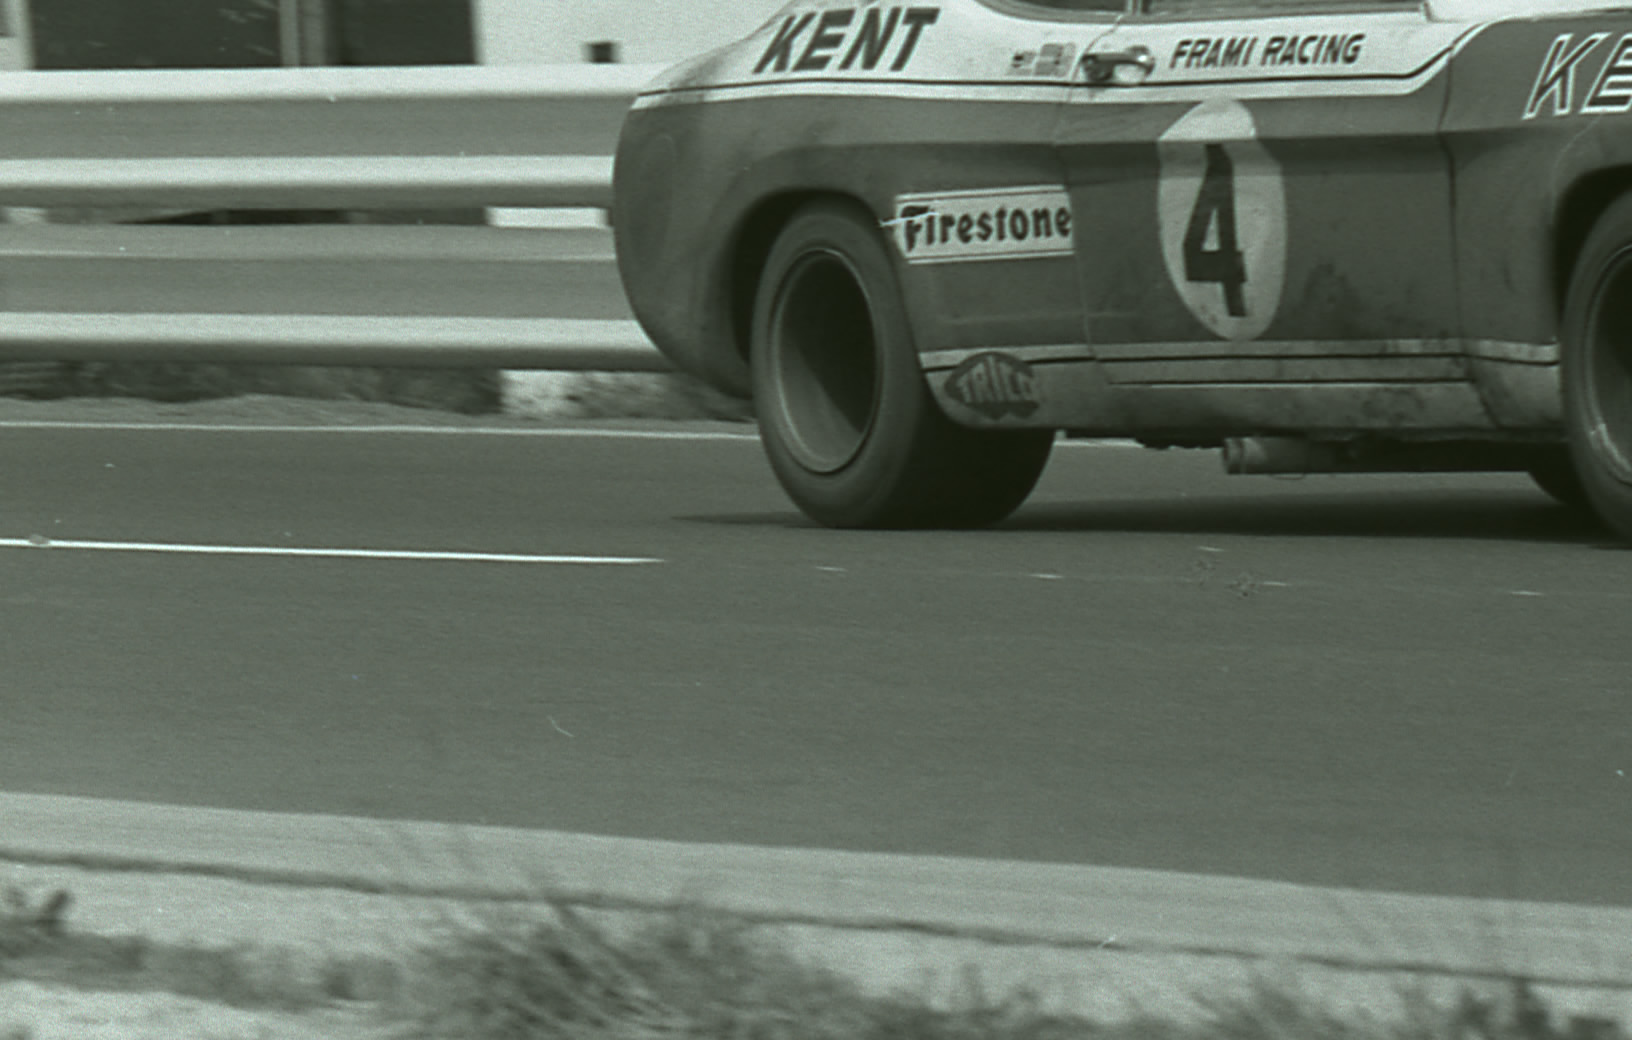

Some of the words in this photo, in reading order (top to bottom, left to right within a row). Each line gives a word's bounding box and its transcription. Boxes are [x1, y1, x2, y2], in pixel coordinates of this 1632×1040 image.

[753, 6, 940, 74] KENT
[1169, 37, 1258, 68] FRAMI
[1260, 33, 1365, 66] RACING
[900, 205, 1073, 253] Firestone
[1182, 143, 1248, 317] 4
